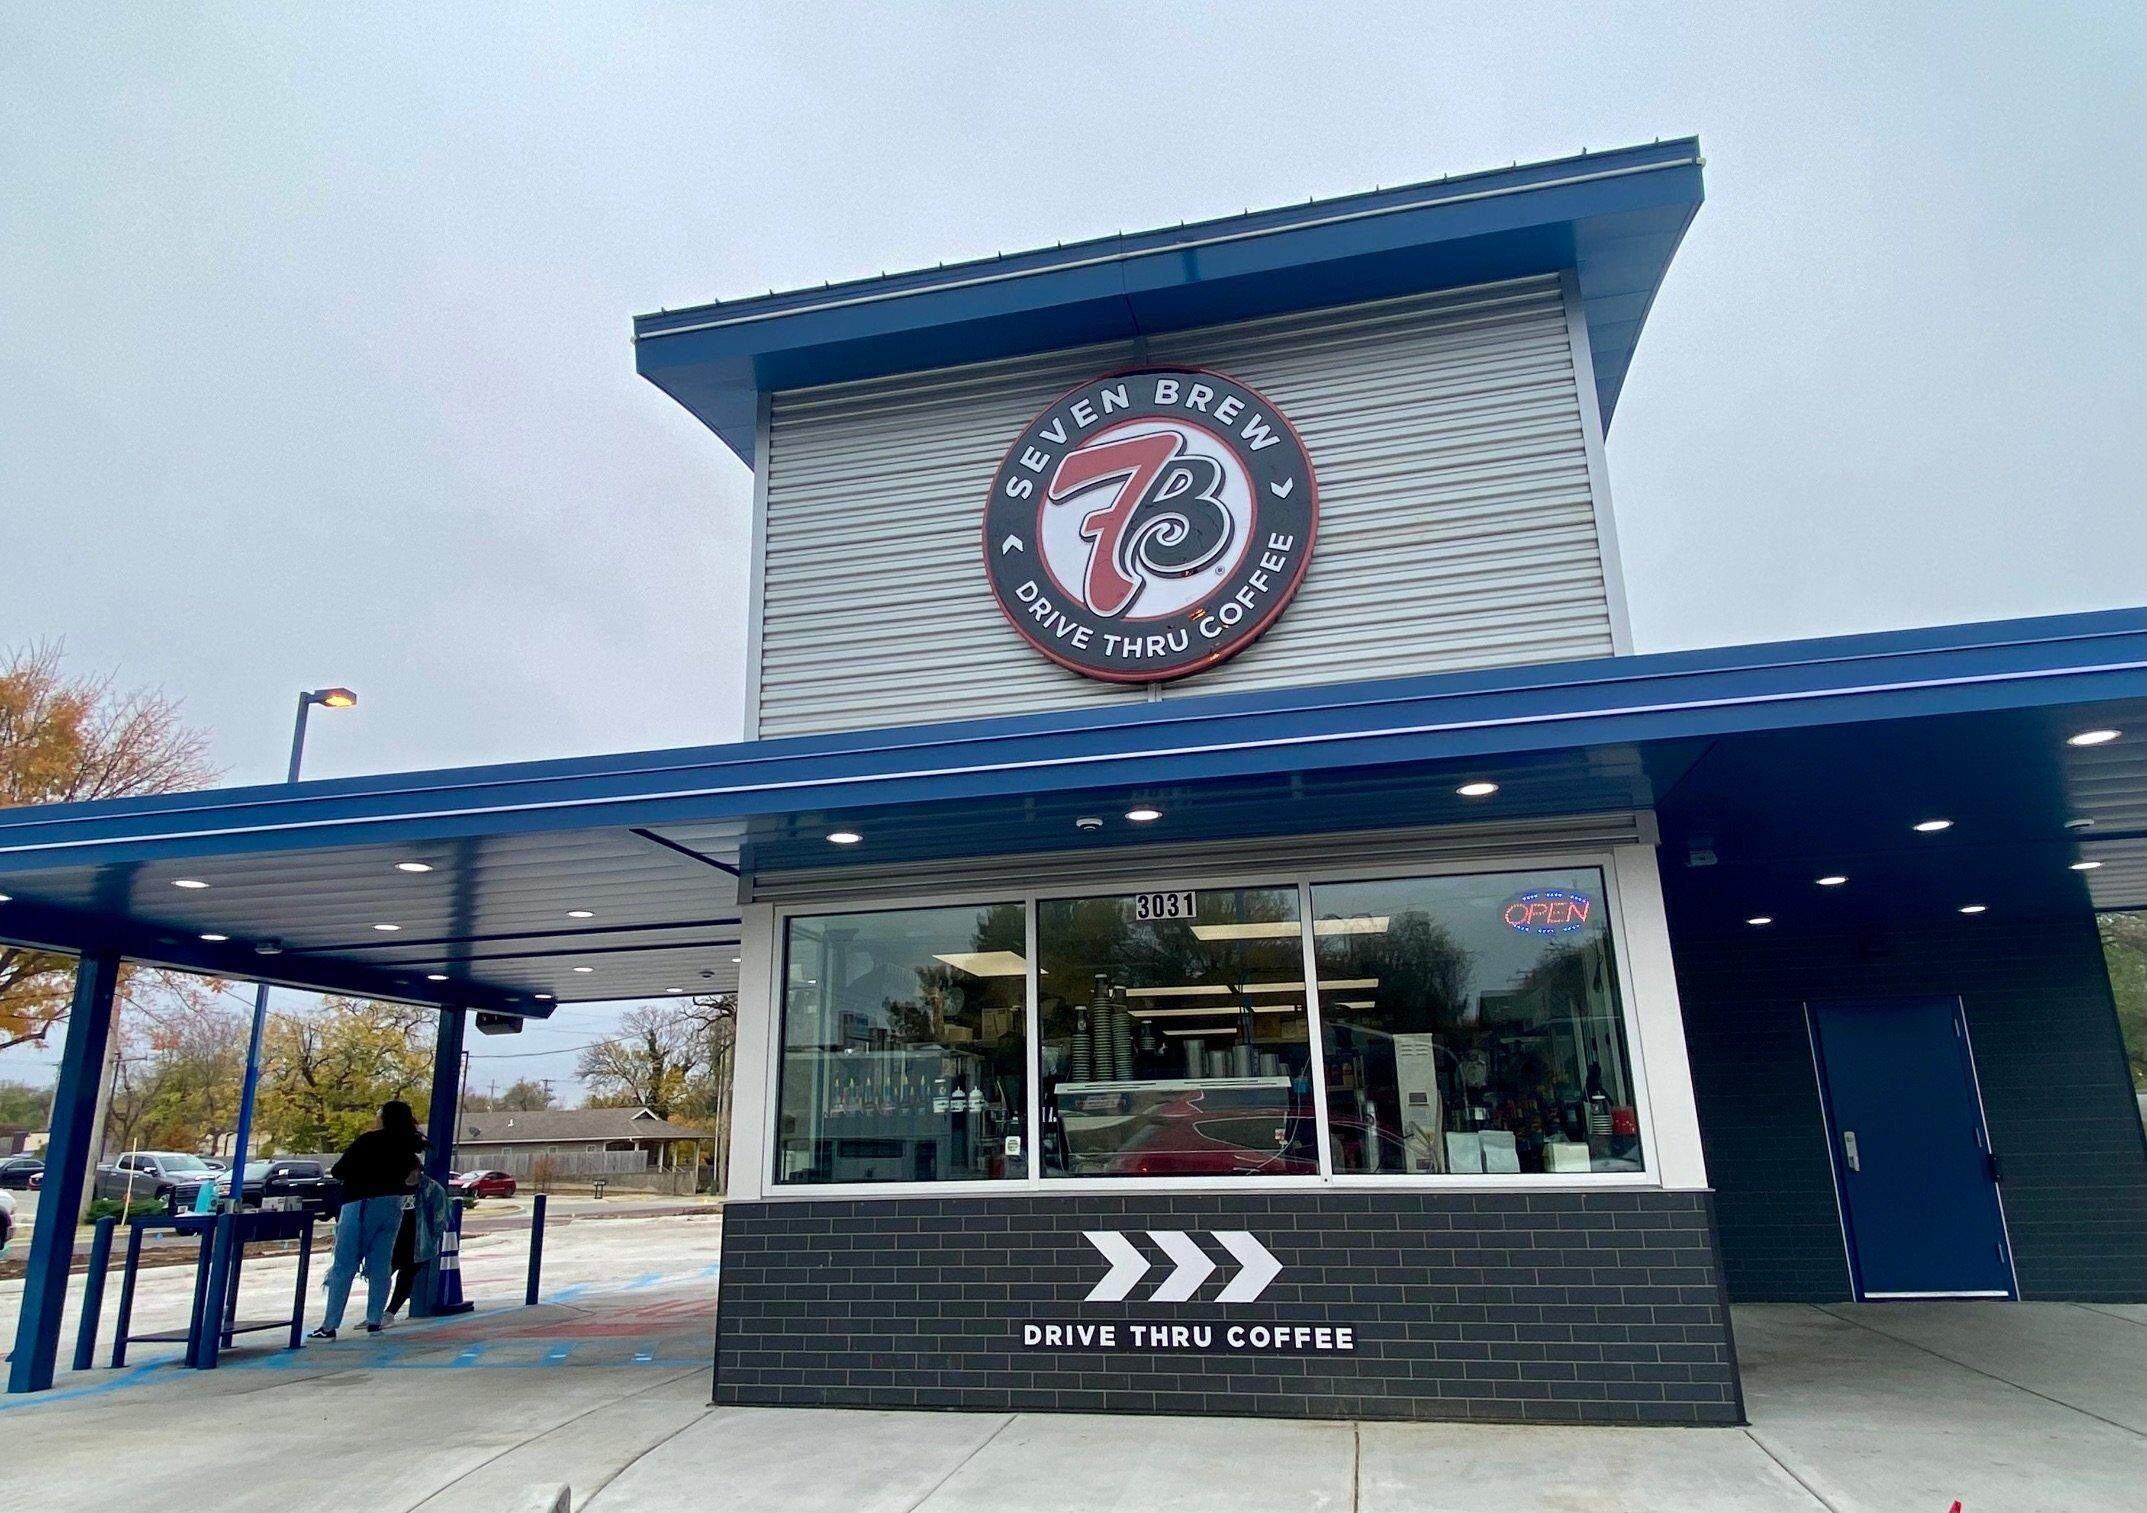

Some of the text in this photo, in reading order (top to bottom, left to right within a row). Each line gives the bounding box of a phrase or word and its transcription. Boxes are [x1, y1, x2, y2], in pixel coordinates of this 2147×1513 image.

[1006, 379, 1281, 500] SEVEN BREW
[1015, 532, 1295, 659] DRIVE THRU COFFEE
[1137, 893, 1194, 919] 3031
[1504, 900, 1590, 926] OPEN
[1023, 1324, 1354, 1350] DRIVE THRU COFFEE
